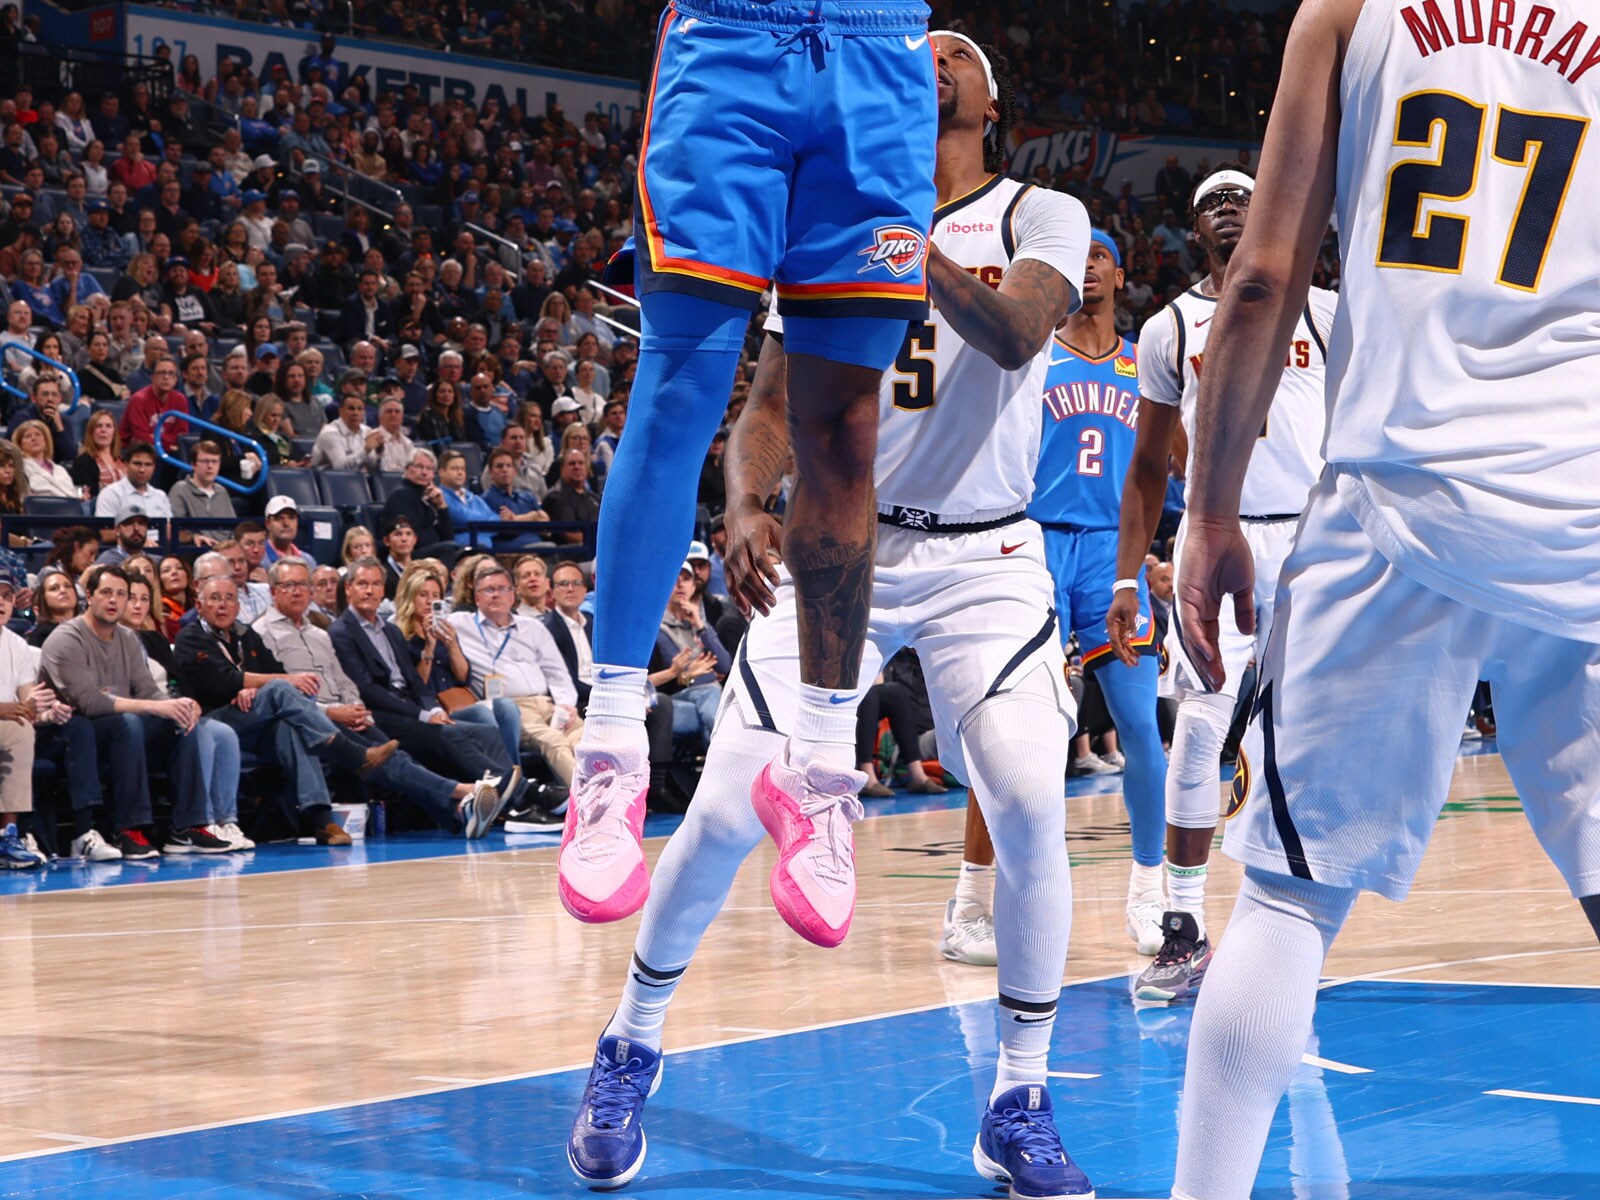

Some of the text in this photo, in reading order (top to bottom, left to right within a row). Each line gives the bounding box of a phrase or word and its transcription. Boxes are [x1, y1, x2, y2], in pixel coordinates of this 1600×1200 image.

[216, 43, 557, 123] BAKETBALL
[1375, 88, 1592, 293] 27
[871, 238, 917, 264] OKC
[946, 222, 994, 234] ibotta
[892, 320, 938, 412] 5
[1042, 381, 1140, 431] THUNDER
[1078, 427, 1104, 476] 2
